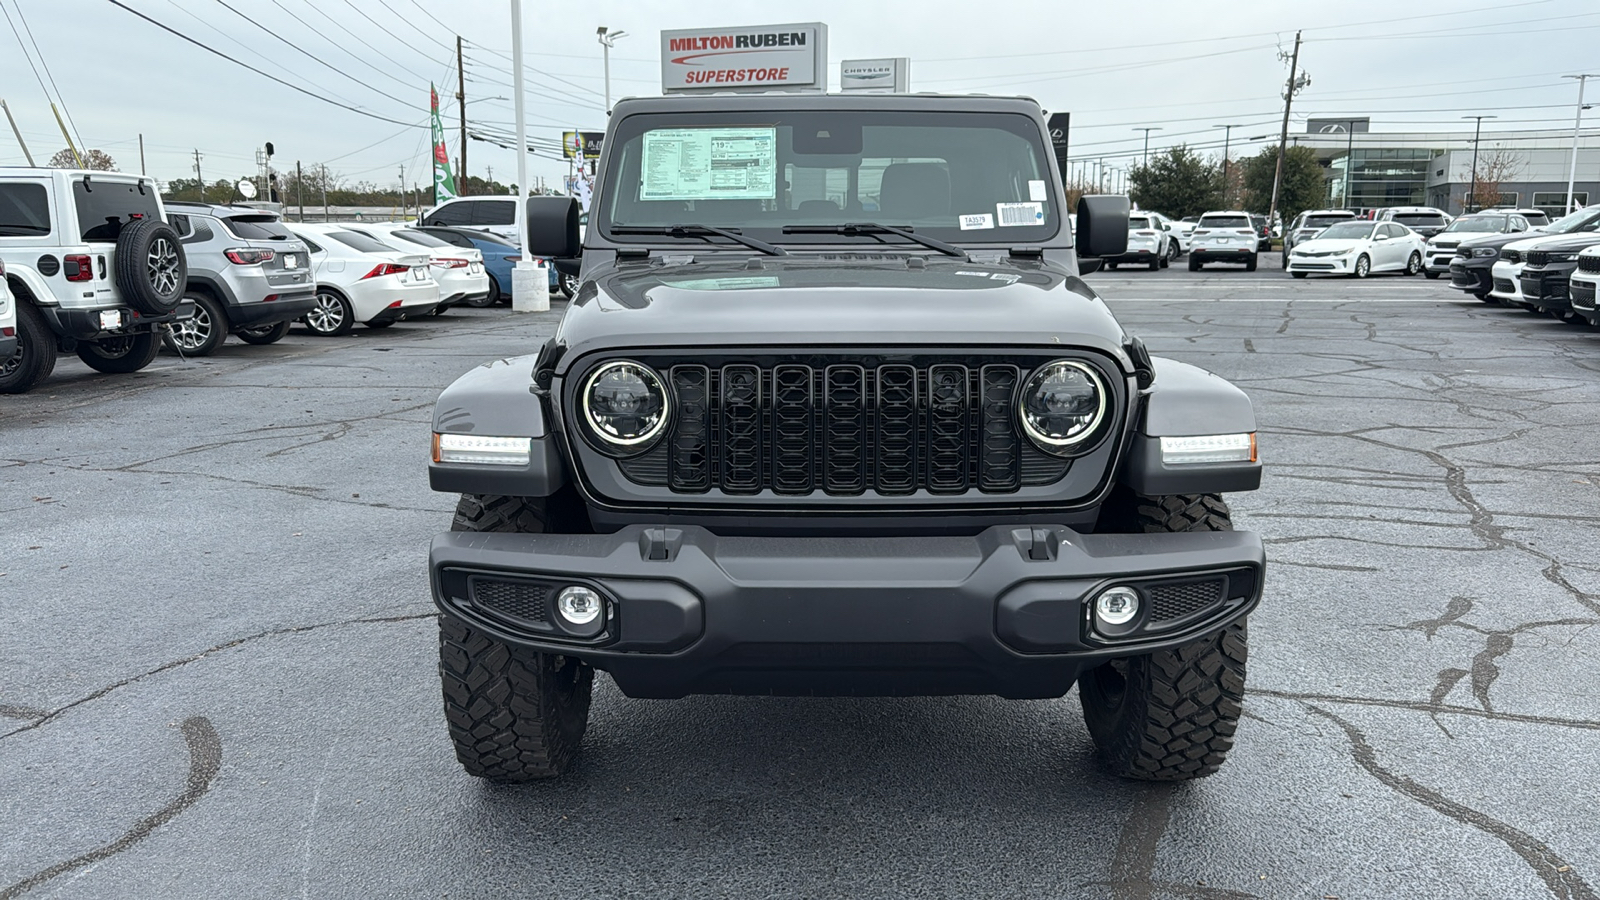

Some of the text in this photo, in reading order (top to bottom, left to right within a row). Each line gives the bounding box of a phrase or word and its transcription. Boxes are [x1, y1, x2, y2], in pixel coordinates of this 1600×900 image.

[844, 66, 890, 74] CHRYSLER
[685, 67, 790, 84] SUPERSTORE
[716, 141, 725, 149] 19
